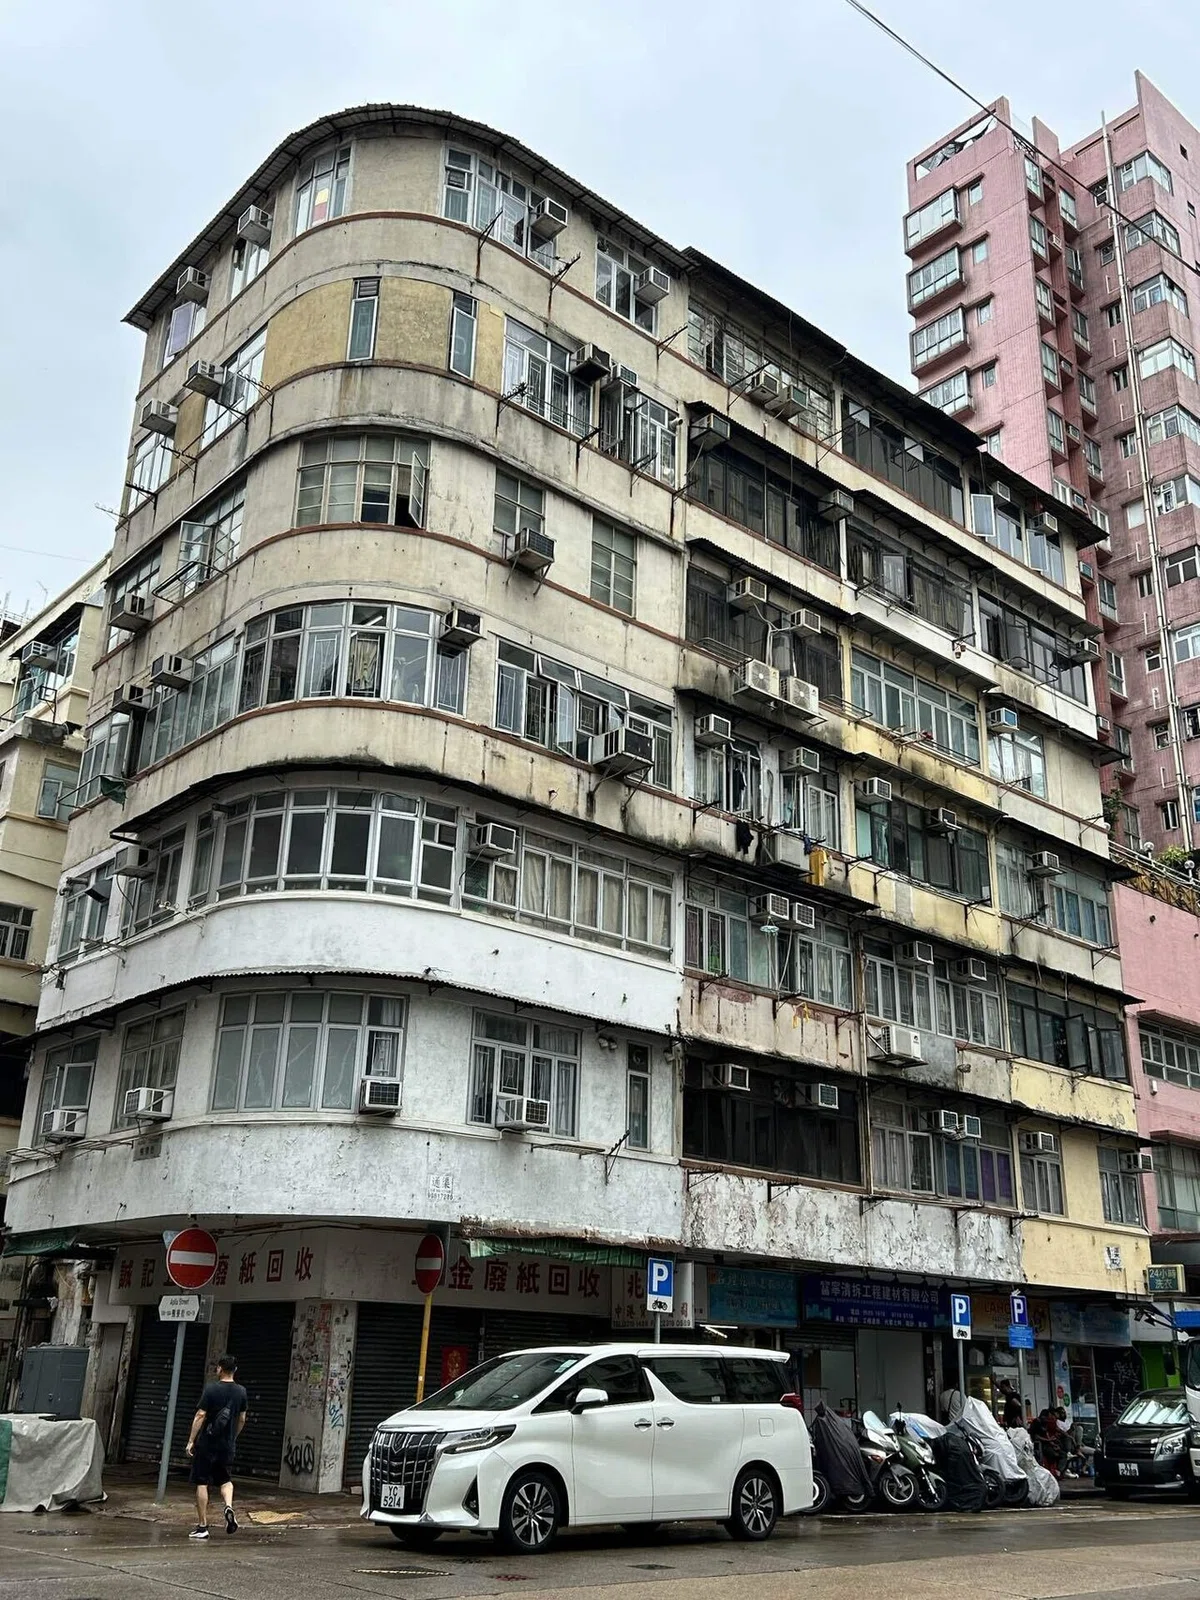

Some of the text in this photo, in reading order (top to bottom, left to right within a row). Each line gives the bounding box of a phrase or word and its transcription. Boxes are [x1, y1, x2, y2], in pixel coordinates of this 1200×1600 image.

[412, 1255, 601, 1299] 金廢紙回收
[653, 1263, 669, 1292] P
[1149, 1268, 1176, 1279] 24小時
[1155, 1278, 1173, 1289] 洗衣
[954, 1298, 967, 1323] P
[1013, 1298, 1024, 1323] P
[388, 1486, 399, 1497] YC
[383, 1496, 401, 1508] 5214
